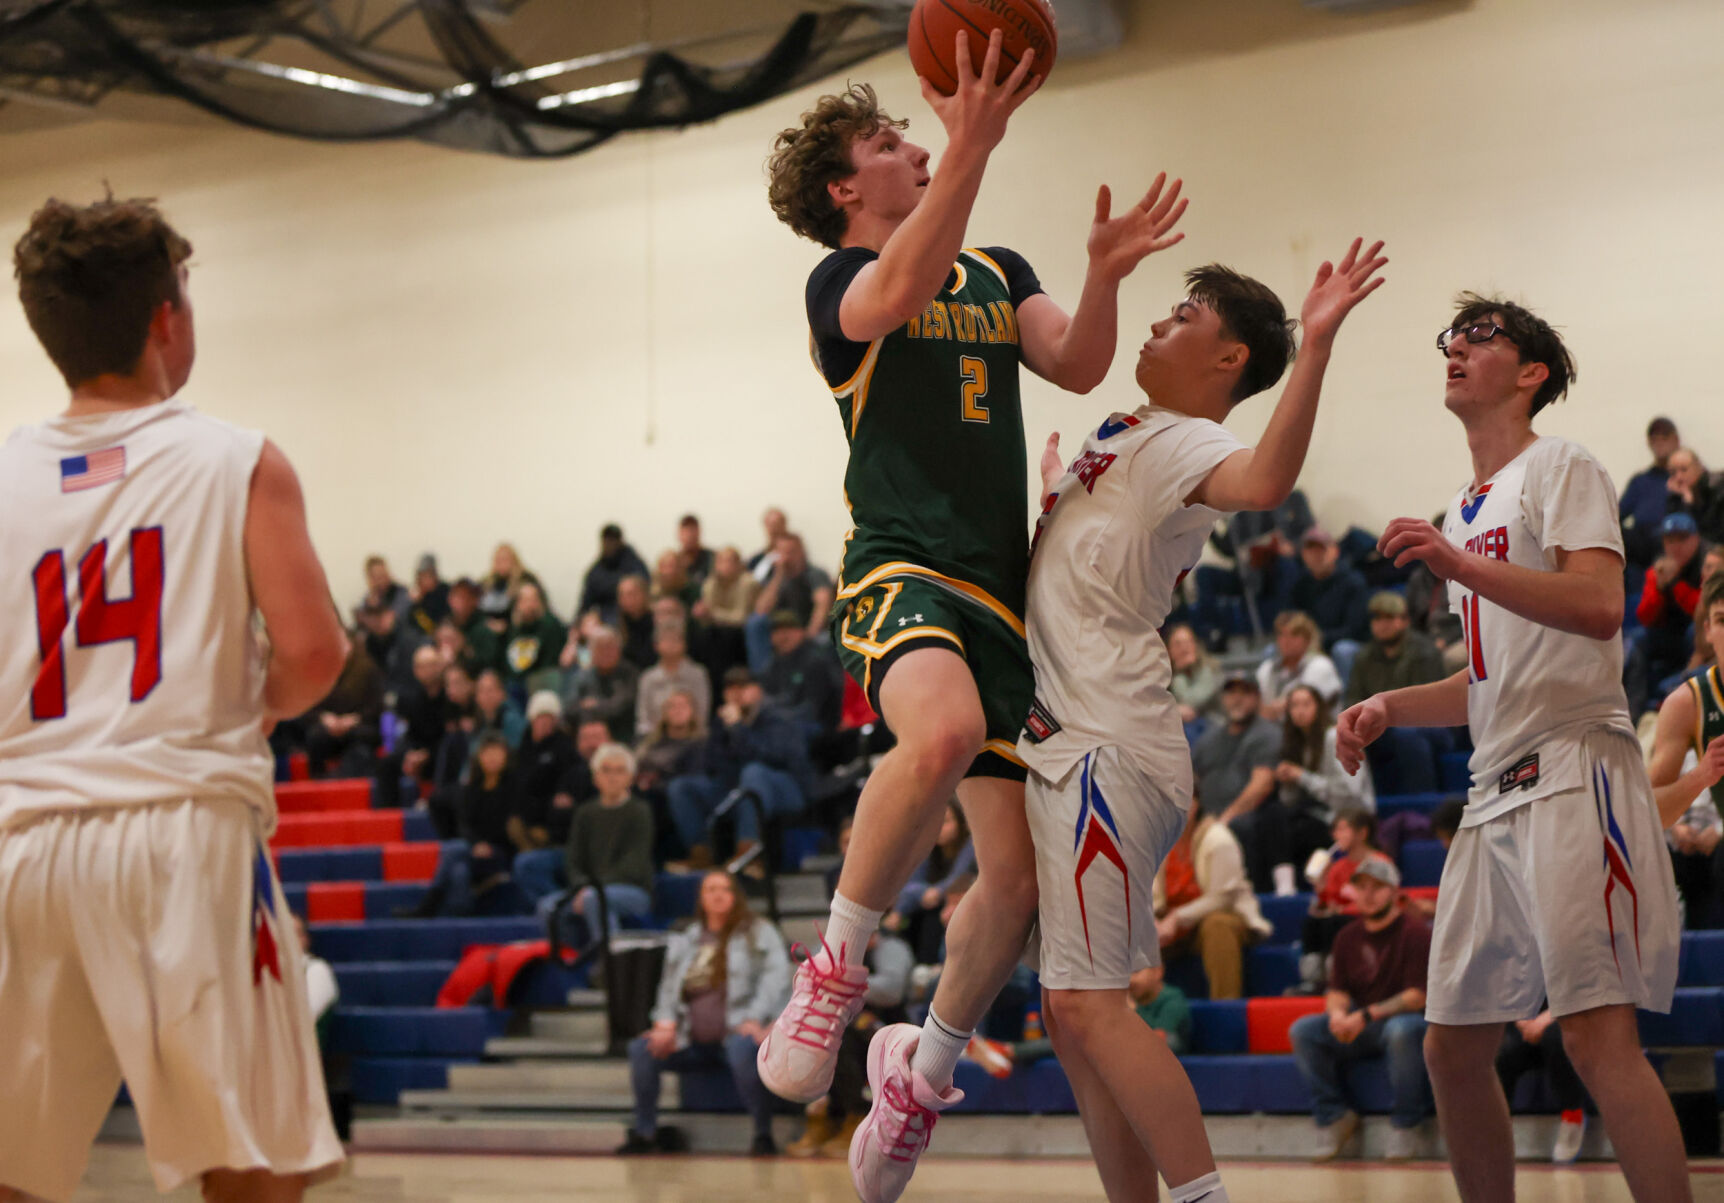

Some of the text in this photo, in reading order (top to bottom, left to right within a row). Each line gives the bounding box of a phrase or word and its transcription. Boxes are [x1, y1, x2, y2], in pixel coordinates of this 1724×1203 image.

[967, 0, 1047, 60] SPALDIN
[948, 301, 1019, 345] RUTLAN
[959, 354, 990, 424] 2
[30, 524, 165, 722] 14
